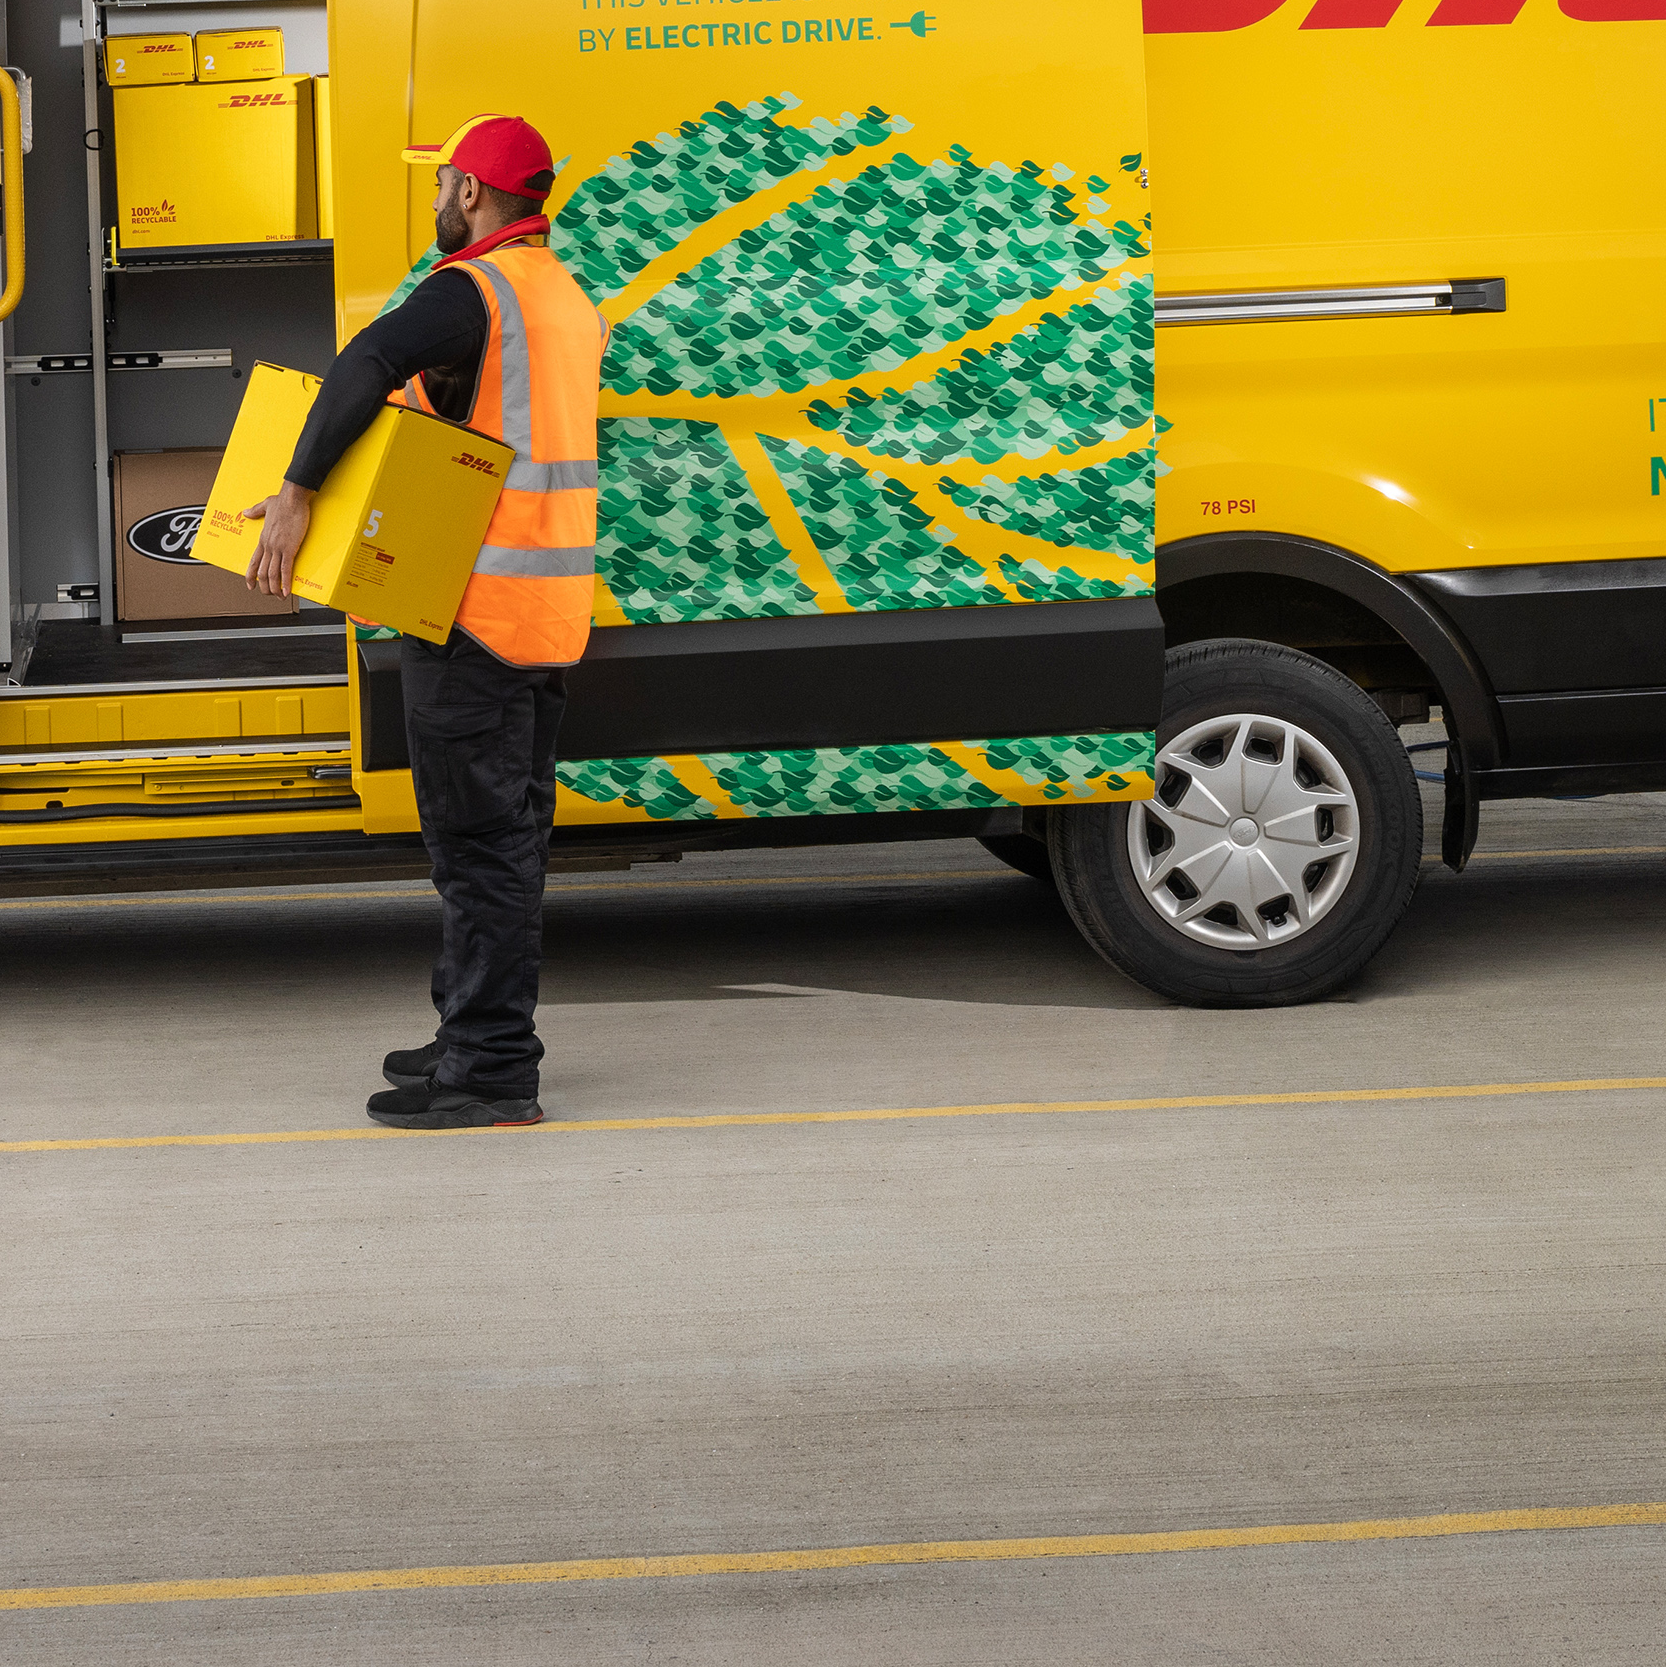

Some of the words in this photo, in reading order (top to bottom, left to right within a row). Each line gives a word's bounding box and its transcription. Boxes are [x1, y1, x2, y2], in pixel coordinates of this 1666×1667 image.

[579, 27, 616, 53] BY
[625, 20, 773, 50] ELECTRIC
[781, 17, 883, 45] DRIVE.
[143, 44, 177, 54] DHL
[234, 40, 268, 50] DHL
[115, 58, 126, 74] 2
[204, 55, 215, 70] 2
[229, 93, 288, 108] DHL
[131, 207, 160, 217] 100%
[132, 216, 177, 225] RECYCLABLE
[280, 233, 304, 241] Express
[458, 452, 495, 475] DHL
[1201, 501, 1221, 515] 78
[1227, 499, 1256, 514] PSI
[212, 509, 234, 525] 100%
[362, 508, 383, 538] 5
[210, 519, 243, 536] RECYCLABLE
[294, 575, 305, 585] DHL
[304, 578, 323, 591] Express
[428, 620, 444, 632] Express
